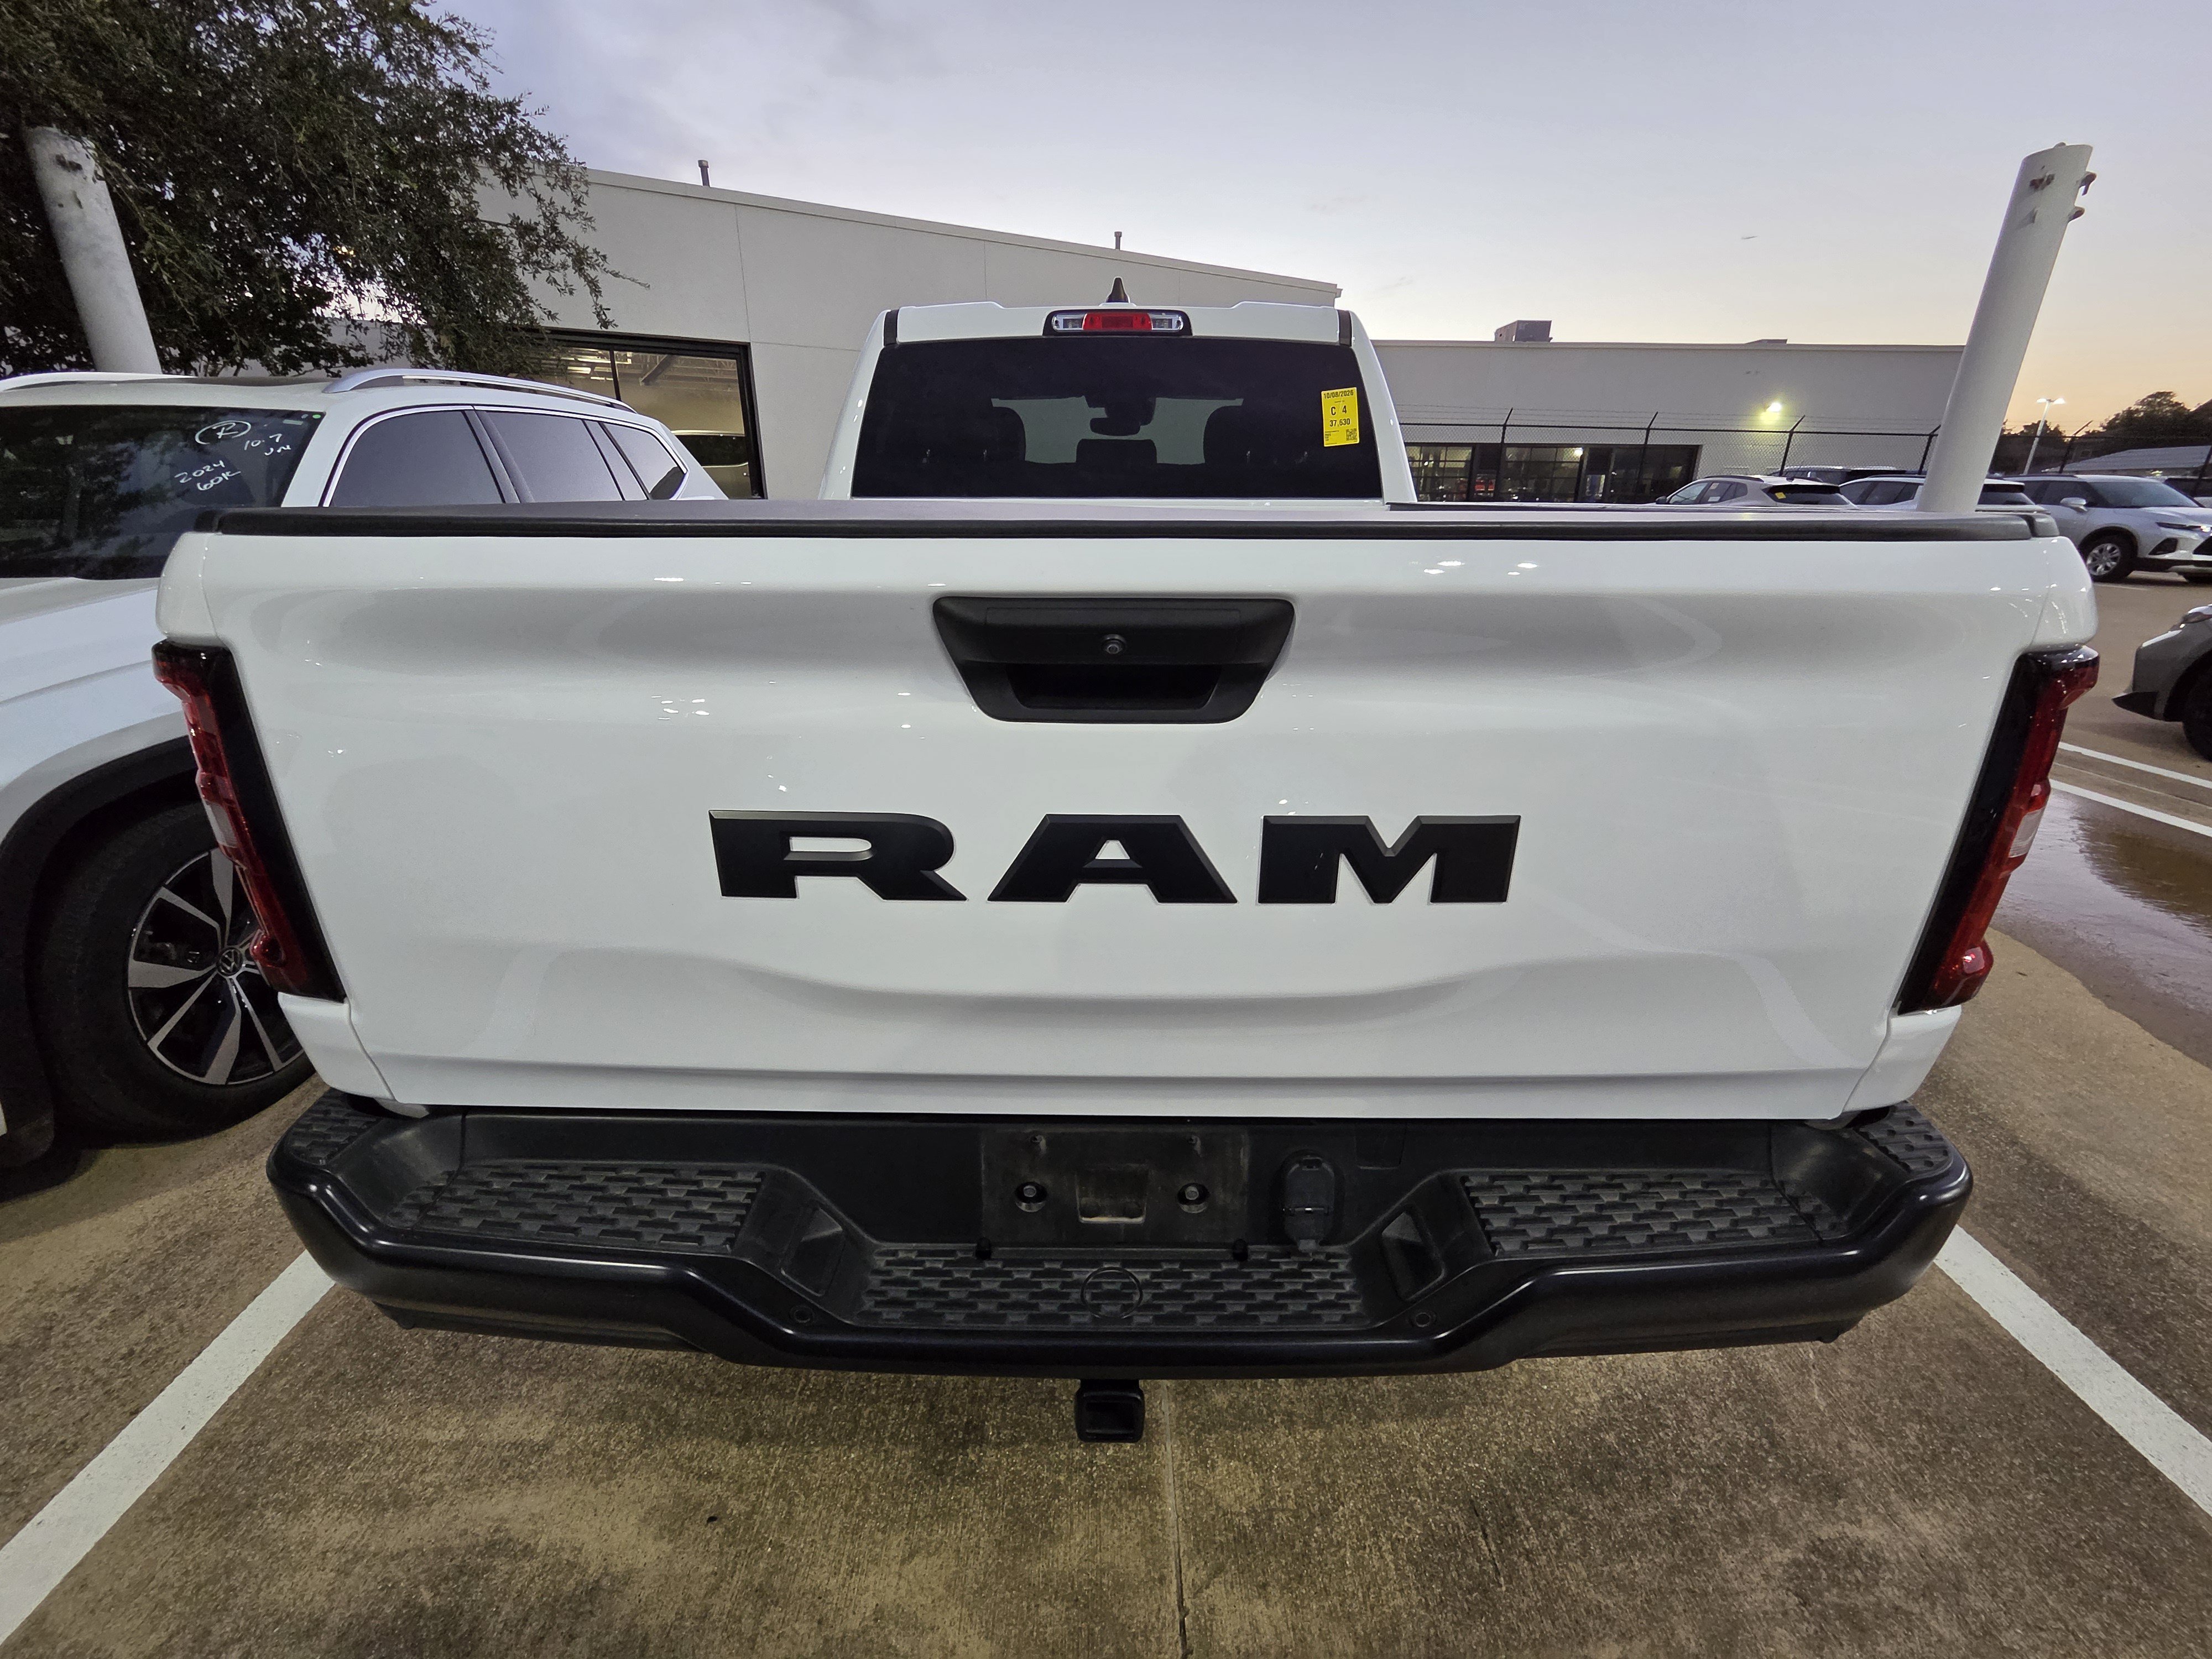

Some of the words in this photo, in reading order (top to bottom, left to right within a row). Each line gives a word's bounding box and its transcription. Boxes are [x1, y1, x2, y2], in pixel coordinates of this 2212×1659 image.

[1331, 406, 1336, 415] C
[1342, 405, 1347, 414] 4
[1329, 418, 1350, 427] 37,630
[174, 460, 225, 483] 2024
[708, 810, 1521, 904] RAM
